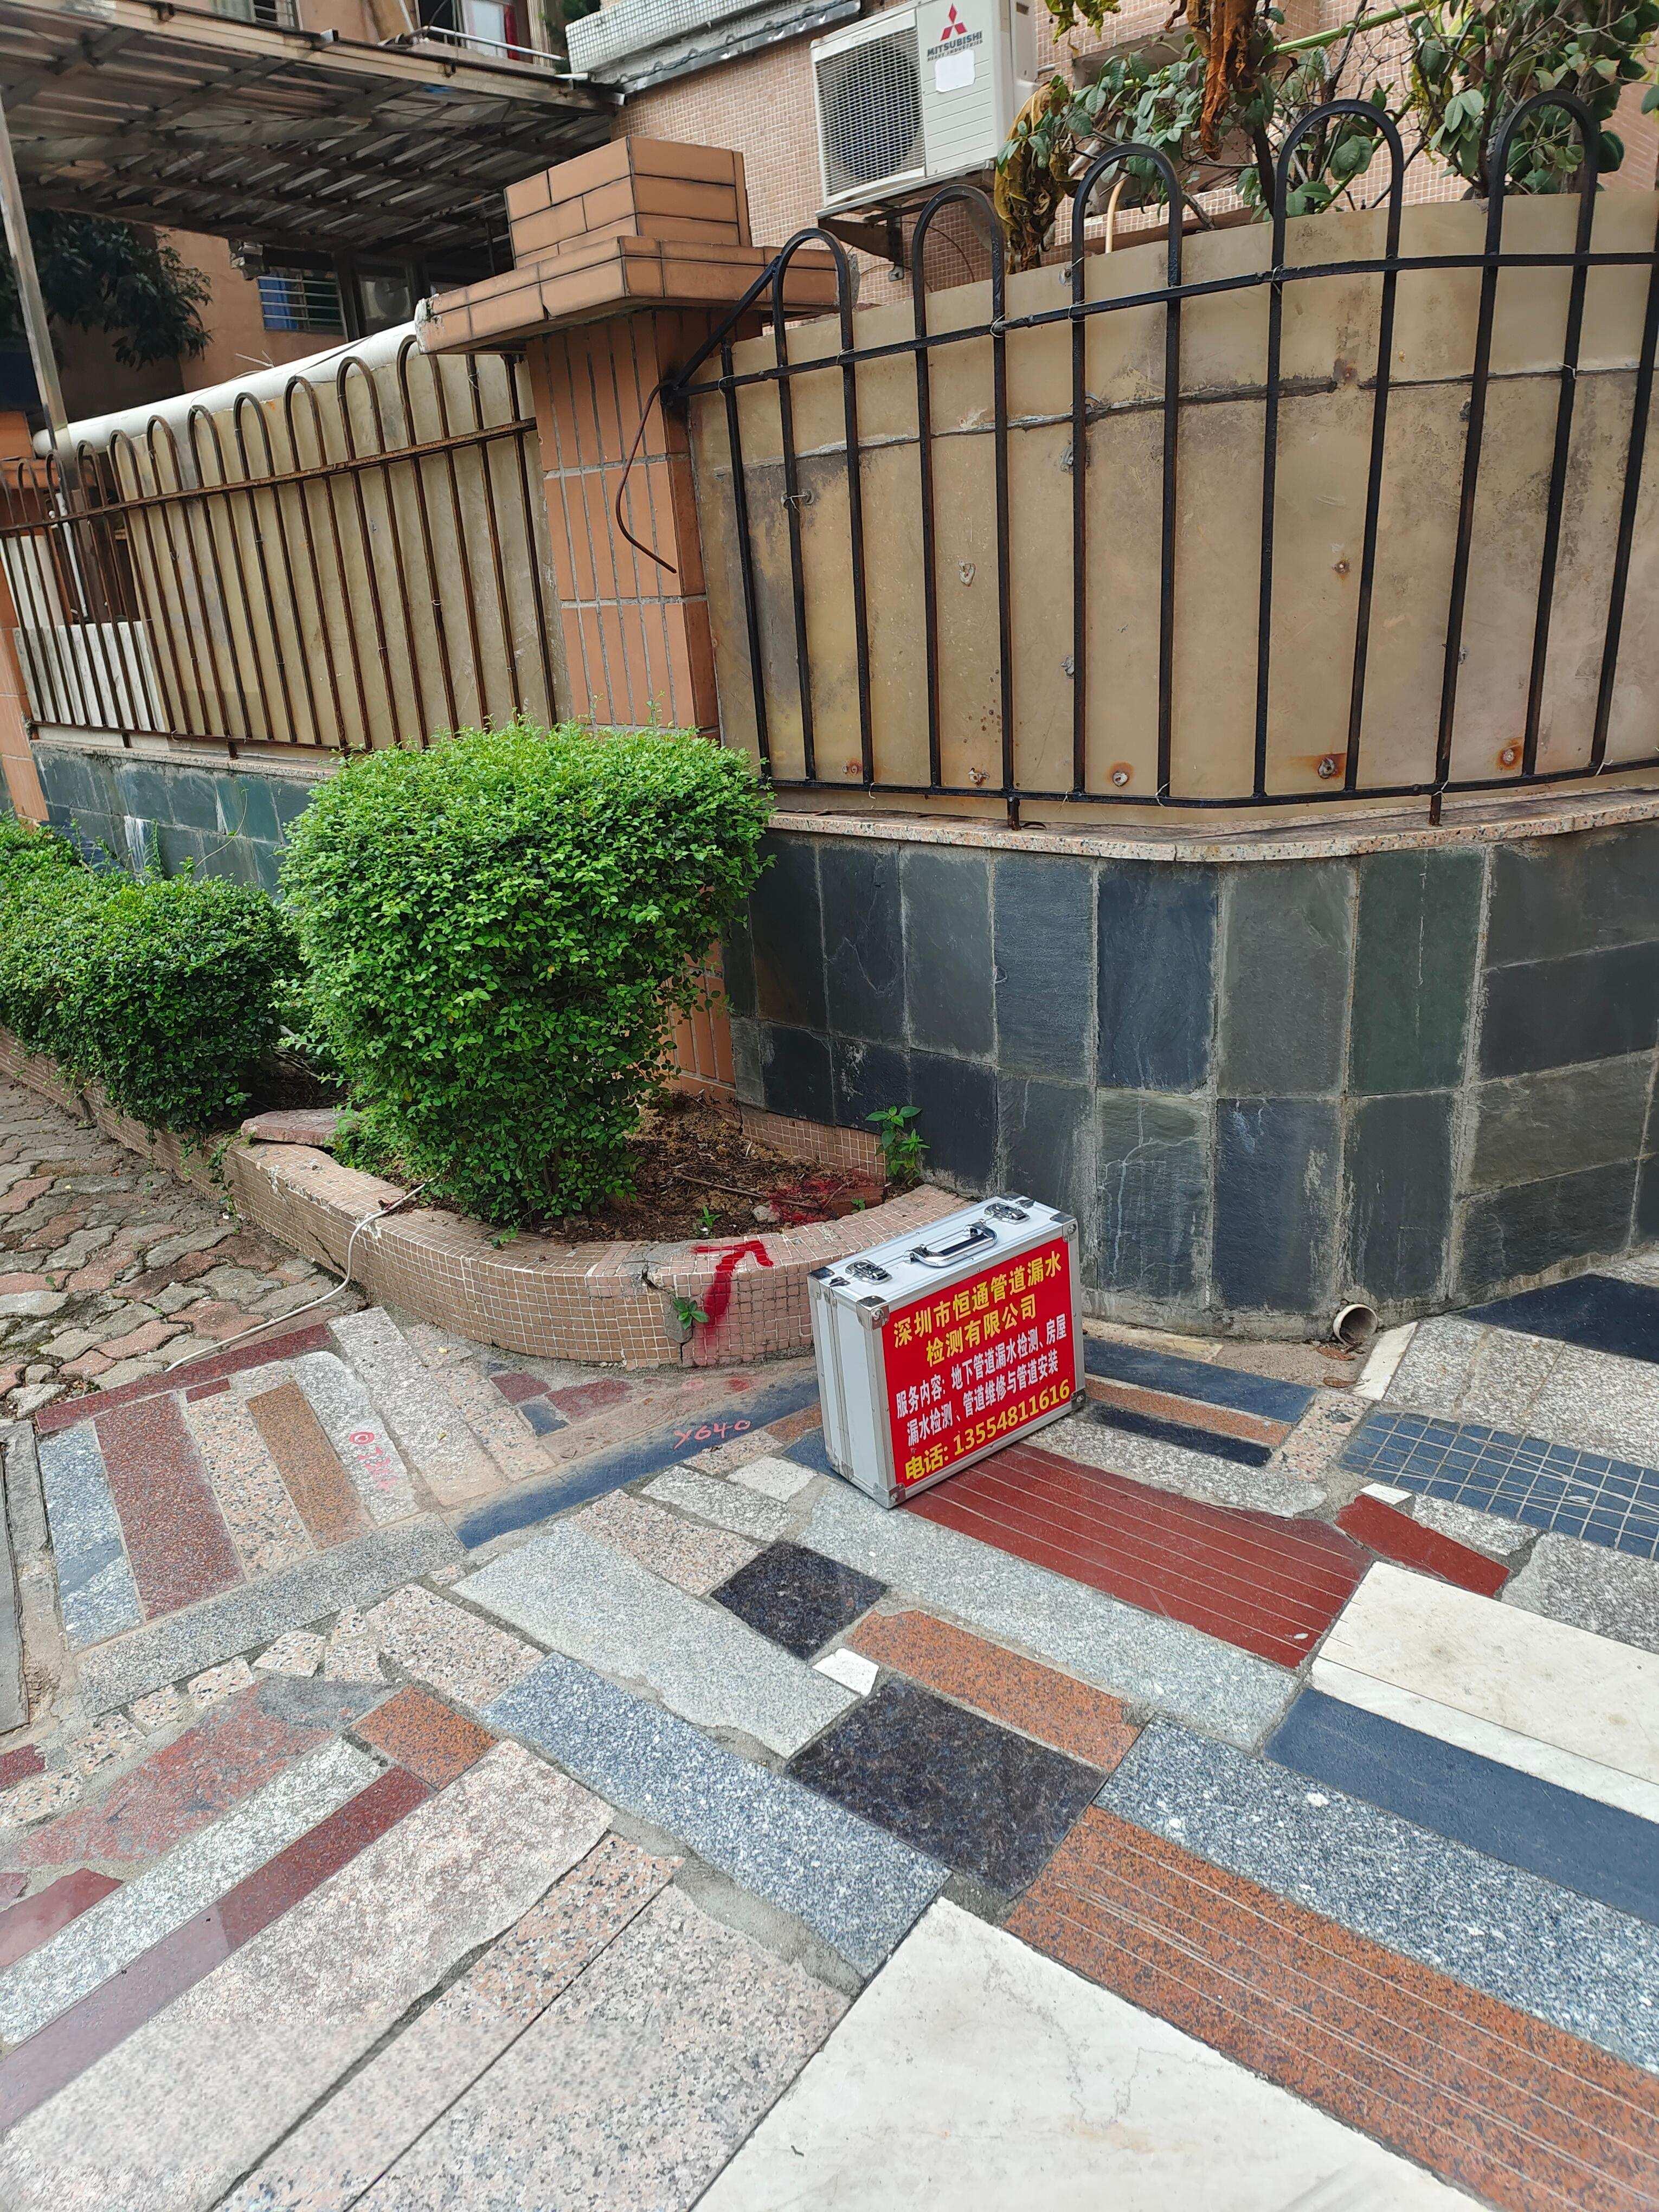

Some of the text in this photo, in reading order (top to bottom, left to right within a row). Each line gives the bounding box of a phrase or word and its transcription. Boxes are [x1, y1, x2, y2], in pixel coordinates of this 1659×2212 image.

[927, 30, 982, 57] MITSUBISHI
[893, 1250, 1062, 1348] 深圳市恒通管道漏水
[926, 1294, 1037, 1367] 检测有限公司
[907, 1348, 1059, 1446] 漏水检测、管道维修与管道安装
